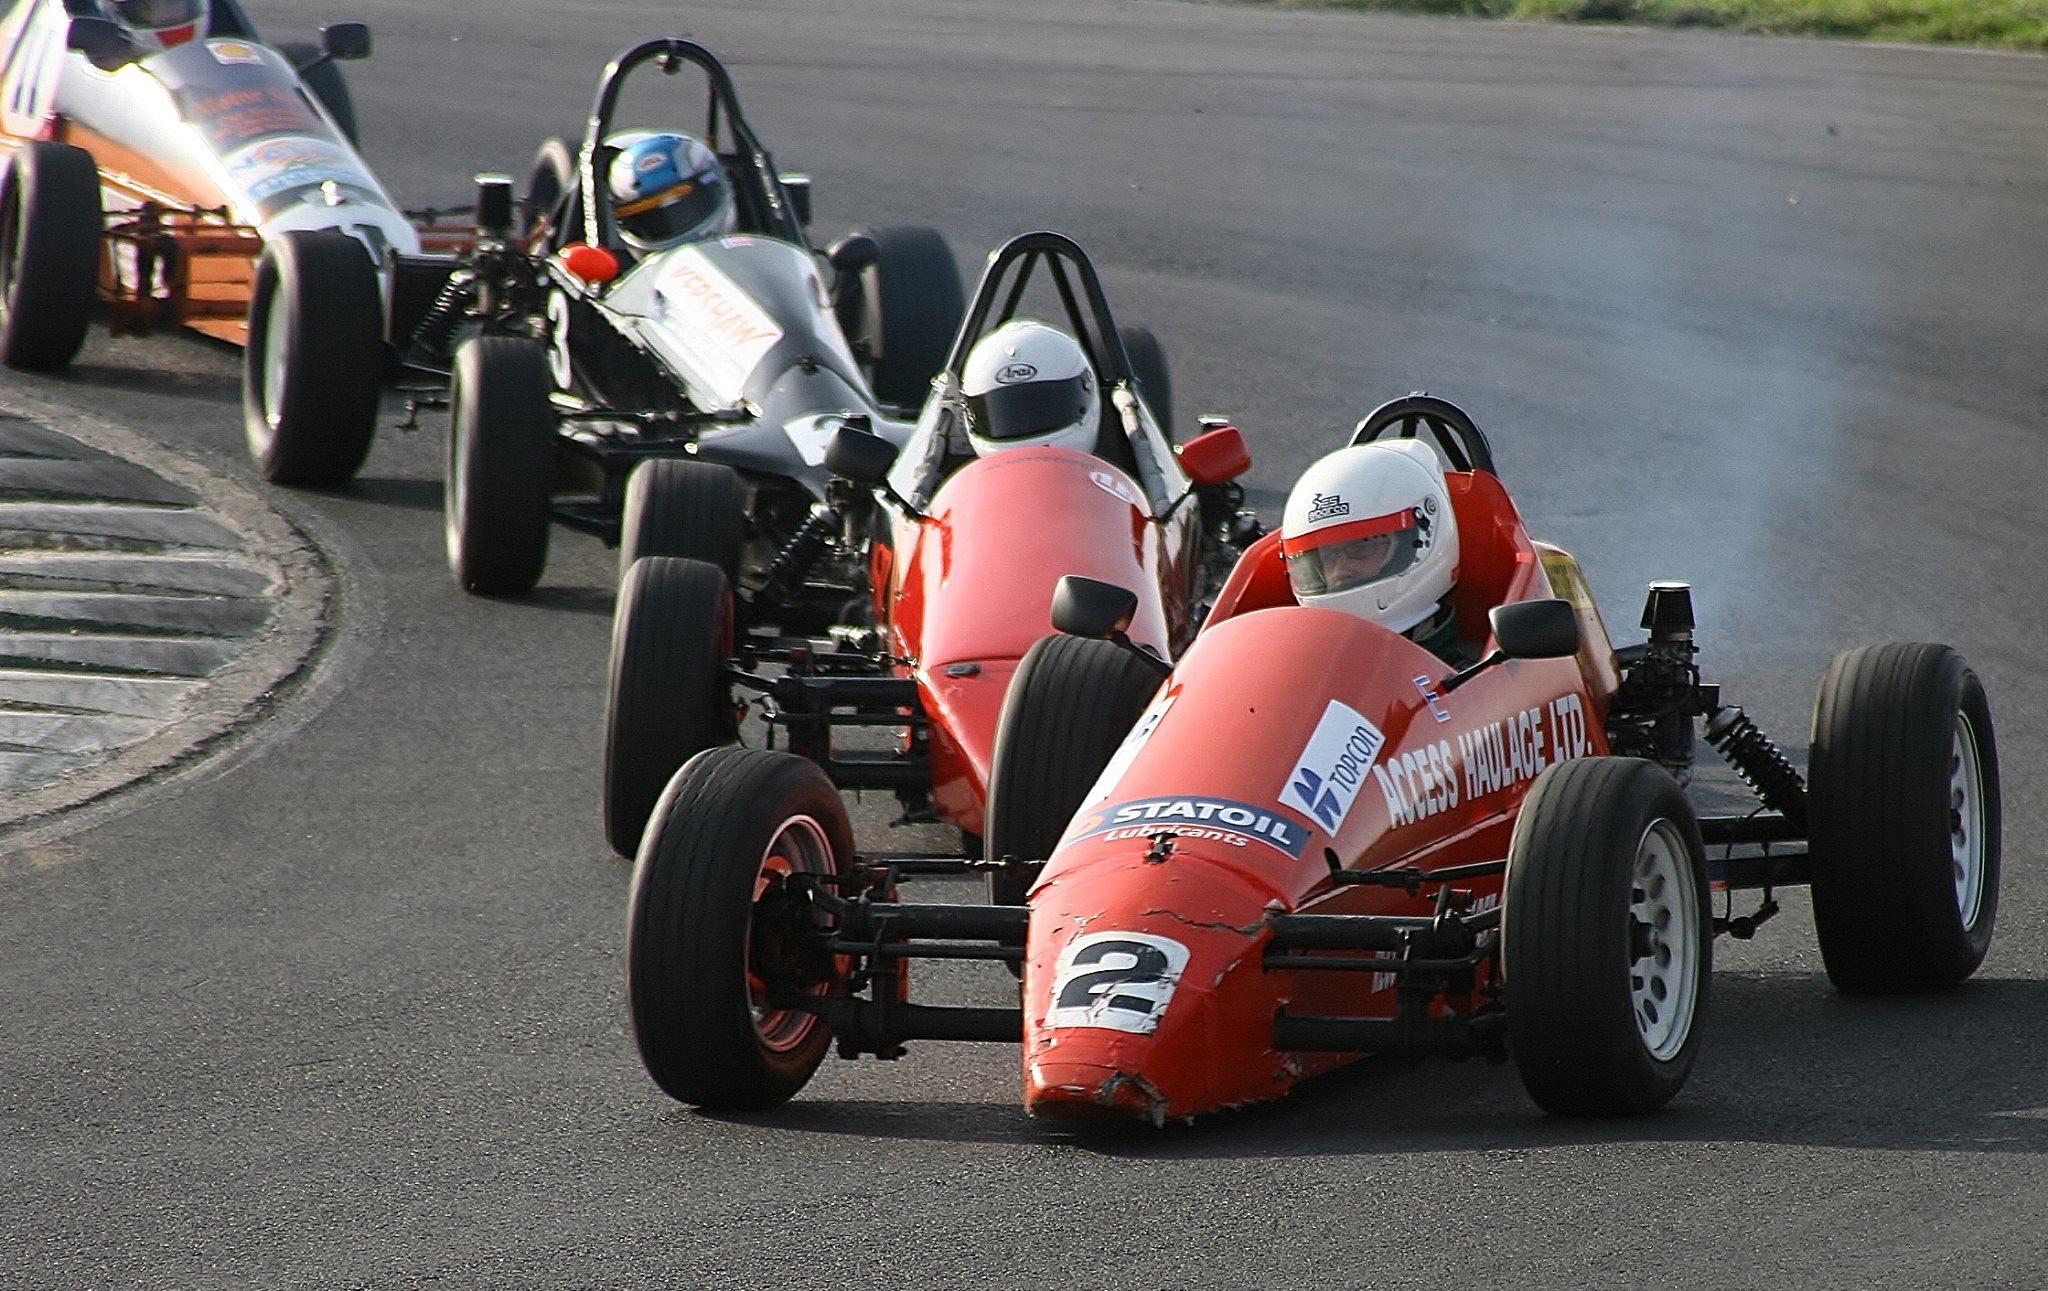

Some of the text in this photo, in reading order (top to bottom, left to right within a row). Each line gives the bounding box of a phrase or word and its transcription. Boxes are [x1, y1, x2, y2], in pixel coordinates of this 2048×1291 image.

[1309, 503, 1348, 520] sparco
[1413, 674, 1452, 723] E
[1329, 725, 1380, 794] TOPCON
[1371, 693, 1593, 830] ACCESS HAULAGE LTD.
[1103, 825, 1250, 848] Lubricants
[1112, 799, 1292, 846] STATOIL
[1056, 939, 1169, 1015] 2
